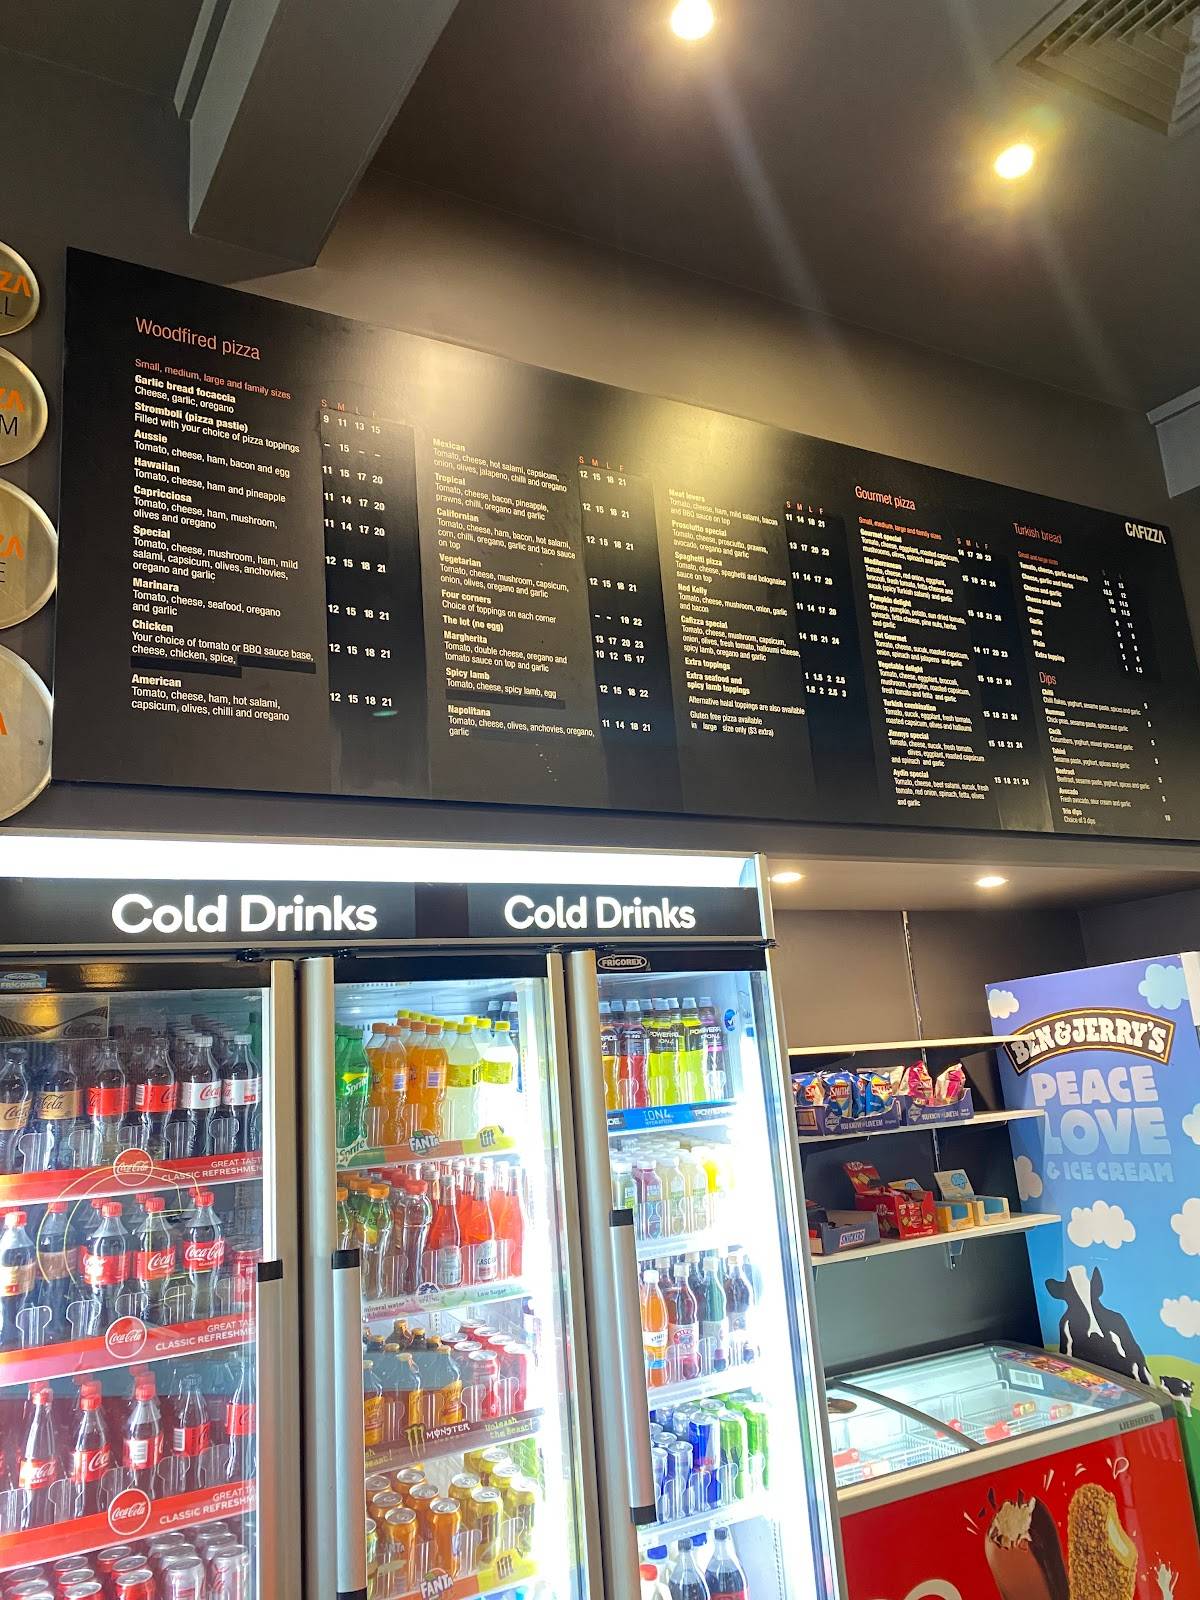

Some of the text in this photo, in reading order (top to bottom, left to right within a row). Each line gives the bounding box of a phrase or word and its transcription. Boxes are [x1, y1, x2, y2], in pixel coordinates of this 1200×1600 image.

[136, 317, 260, 360] Woodfired pizza
[136, 359, 290, 399] Small, medium, large and family sizes
[135, 375, 235, 403] Garlic bread focaccia
[135, 386, 234, 413] Cheese, garlic, oregano
[135, 402, 182, 421] Stromboli
[185, 412, 213, 425] (pizza
[322, 414, 381, 434] 9 11 13 15
[134, 429, 167, 443] Aussie
[135, 413, 299, 453] Filled with your choice of pizza toppings
[134, 440, 289, 478] Tomato, cheese, ham, bacon and egg
[134, 457, 179, 473] Hawaiian
[134, 468, 285, 502] Tomato, cheese, ham and pineapple
[435, 473, 465, 485] Tropical
[134, 485, 192, 502] Capricciosa
[855, 486, 915, 510] Gourmet pizza
[134, 496, 277, 529] Tomato, cheese, ham, mushroom,
[134, 510, 216, 529] olives and oregano
[437, 508, 479, 522] Californian
[133, 525, 170, 539] Special
[1013, 523, 1062, 544] Turkish bread
[1125, 522, 1166, 544] CAFIZZA
[439, 553, 481, 570] Vegetarian
[675, 552, 722, 567] Spaghetti pizza
[133, 578, 179, 592] Marinara
[678, 583, 707, 598] Ned Kelly
[442, 589, 491, 604] Four corners
[442, 600, 466, 610] Choice
[476, 605, 506, 617] toppings
[518, 612, 533, 620] each
[535, 615, 556, 623] corner
[133, 619, 173, 632] Chicken
[443, 615, 503, 632] The lot (no egg)
[444, 631, 488, 647] Margherita
[685, 657, 730, 671] Extra toppings
[132, 675, 181, 687] American
[446, 667, 489, 680] Spicy lamb
[1039, 672, 1056, 685] Dips
[132, 687, 280, 709] Tomato, cheese, ham, hot salami,
[329, 692, 392, 707] 12 15 18 21
[448, 705, 490, 716] Napolitana
[111, 893, 378, 934] Cold Drinks
[504, 894, 696, 930] Cold Drinks
[601, 959, 642, 967] FRIGOREX
[1031, 1065, 1159, 1107] PEACE
[1044, 1106, 1172, 1155] LOVE
[409, 1134, 440, 1152] FANTA
[211, 1159, 241, 1169] GREAT
[1046, 1161, 1174, 1183] & ICE CREAM
[161, 1165, 263, 1182] CLASSIC REFRESHMEN
[841, 1230, 865, 1245] SNICKERS
[207, 1322, 237, 1333] GREAT
[109, 1329, 143, 1346] Coca-Cola
[155, 1337, 196, 1351] CLASSIC
[212, 1489, 241, 1502] GREAT
[111, 1502, 146, 1522] Coca-Cola
[159, 1508, 201, 1526] CLASSIC
[420, 1573, 454, 1599] FANTA
